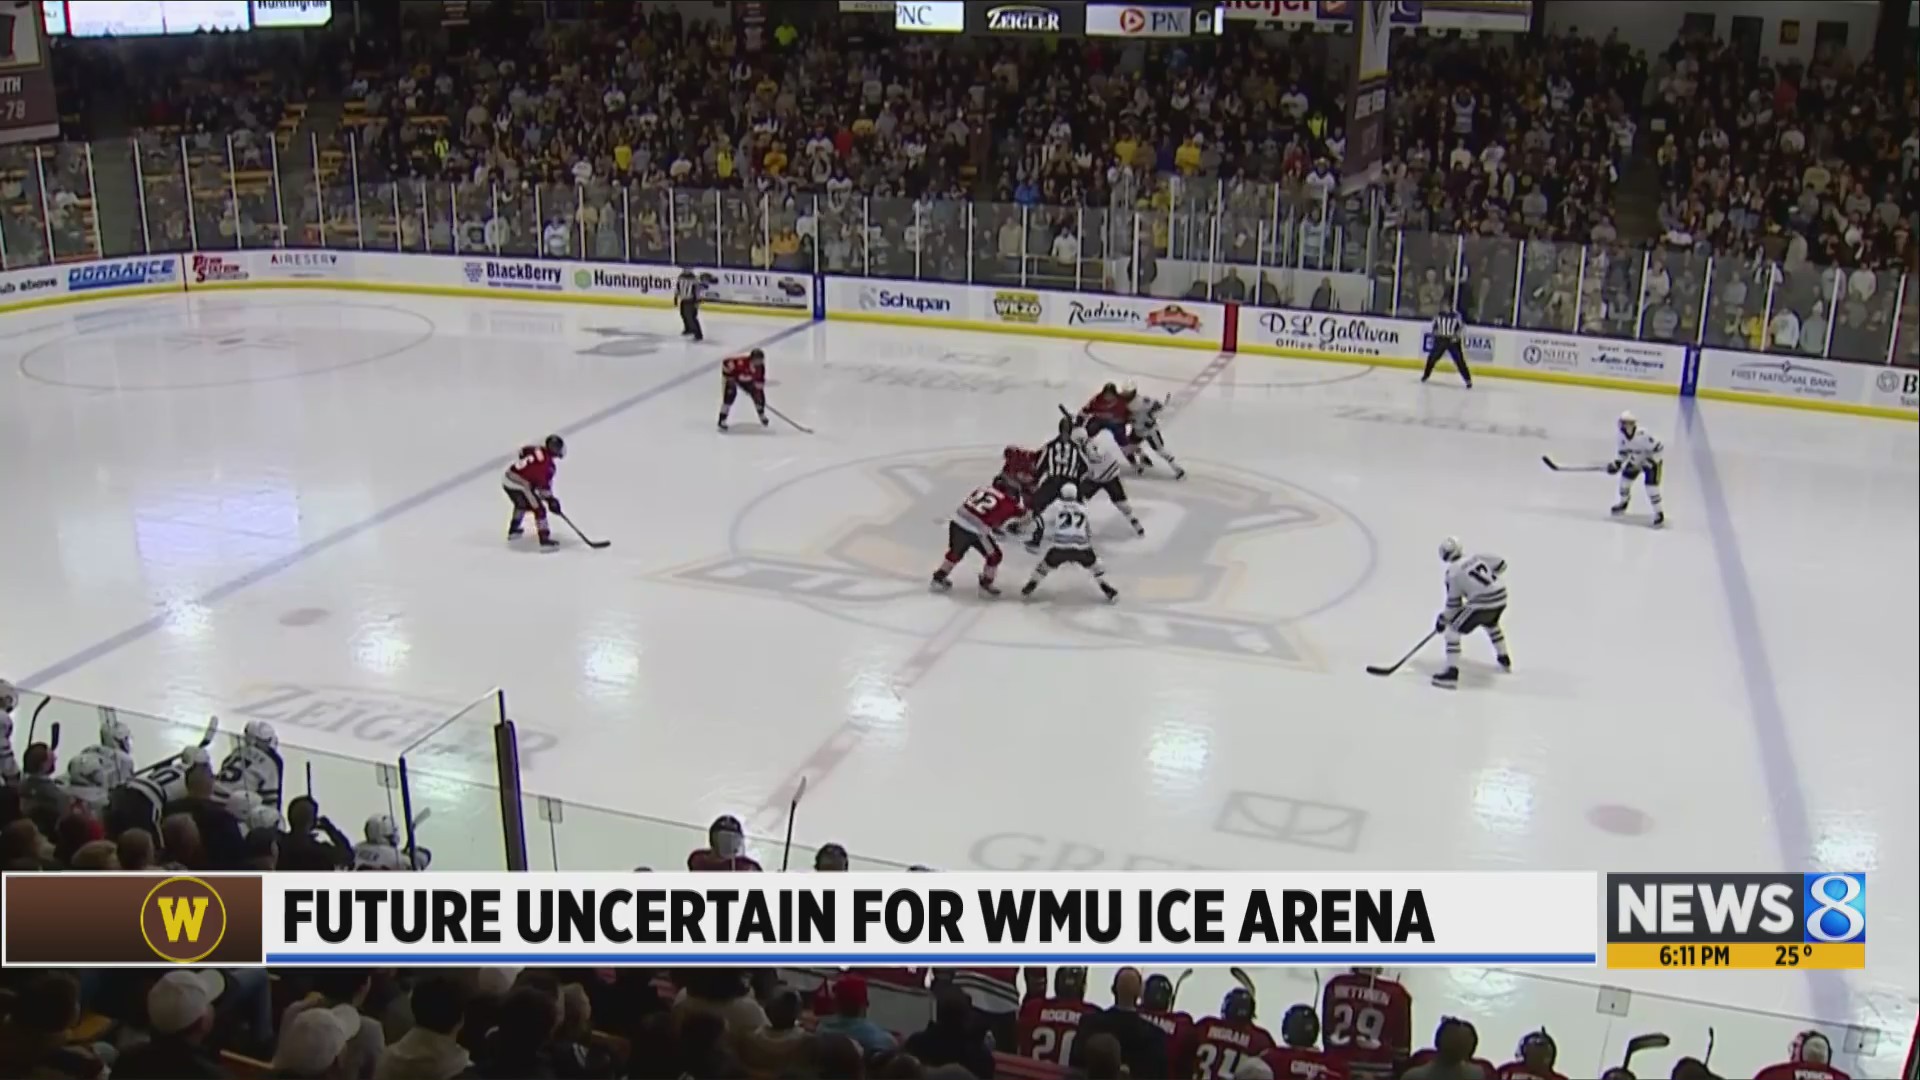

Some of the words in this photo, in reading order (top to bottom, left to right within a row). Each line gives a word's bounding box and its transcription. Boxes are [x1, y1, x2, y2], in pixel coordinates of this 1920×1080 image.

[898, 5, 932, 25] NC
[987, 9, 1060, 31] ZEIGLER
[271, 254, 337, 265] AIRESERV
[68, 259, 175, 283] DORRANCE
[487, 262, 562, 283] BlackBerry
[594, 269, 672, 294] Huntington
[20, 279, 57, 291] above
[879, 290, 950, 313] Schupan
[994, 300, 1042, 316] WKZO
[1069, 300, 1141, 325] Radisson
[1260, 312, 1289, 334] D.
[1291, 315, 1317, 336] L.
[1320, 316, 1399, 344] Gallivan
[1276, 338, 1313, 351] Office
[1320, 341, 1380, 356] Solutions
[1732, 368, 1757, 381] FIRST
[1762, 371, 1807, 385] NATIONAL
[1810, 377, 1837, 388] BANK
[1330, 1004, 1384, 1049] 29
